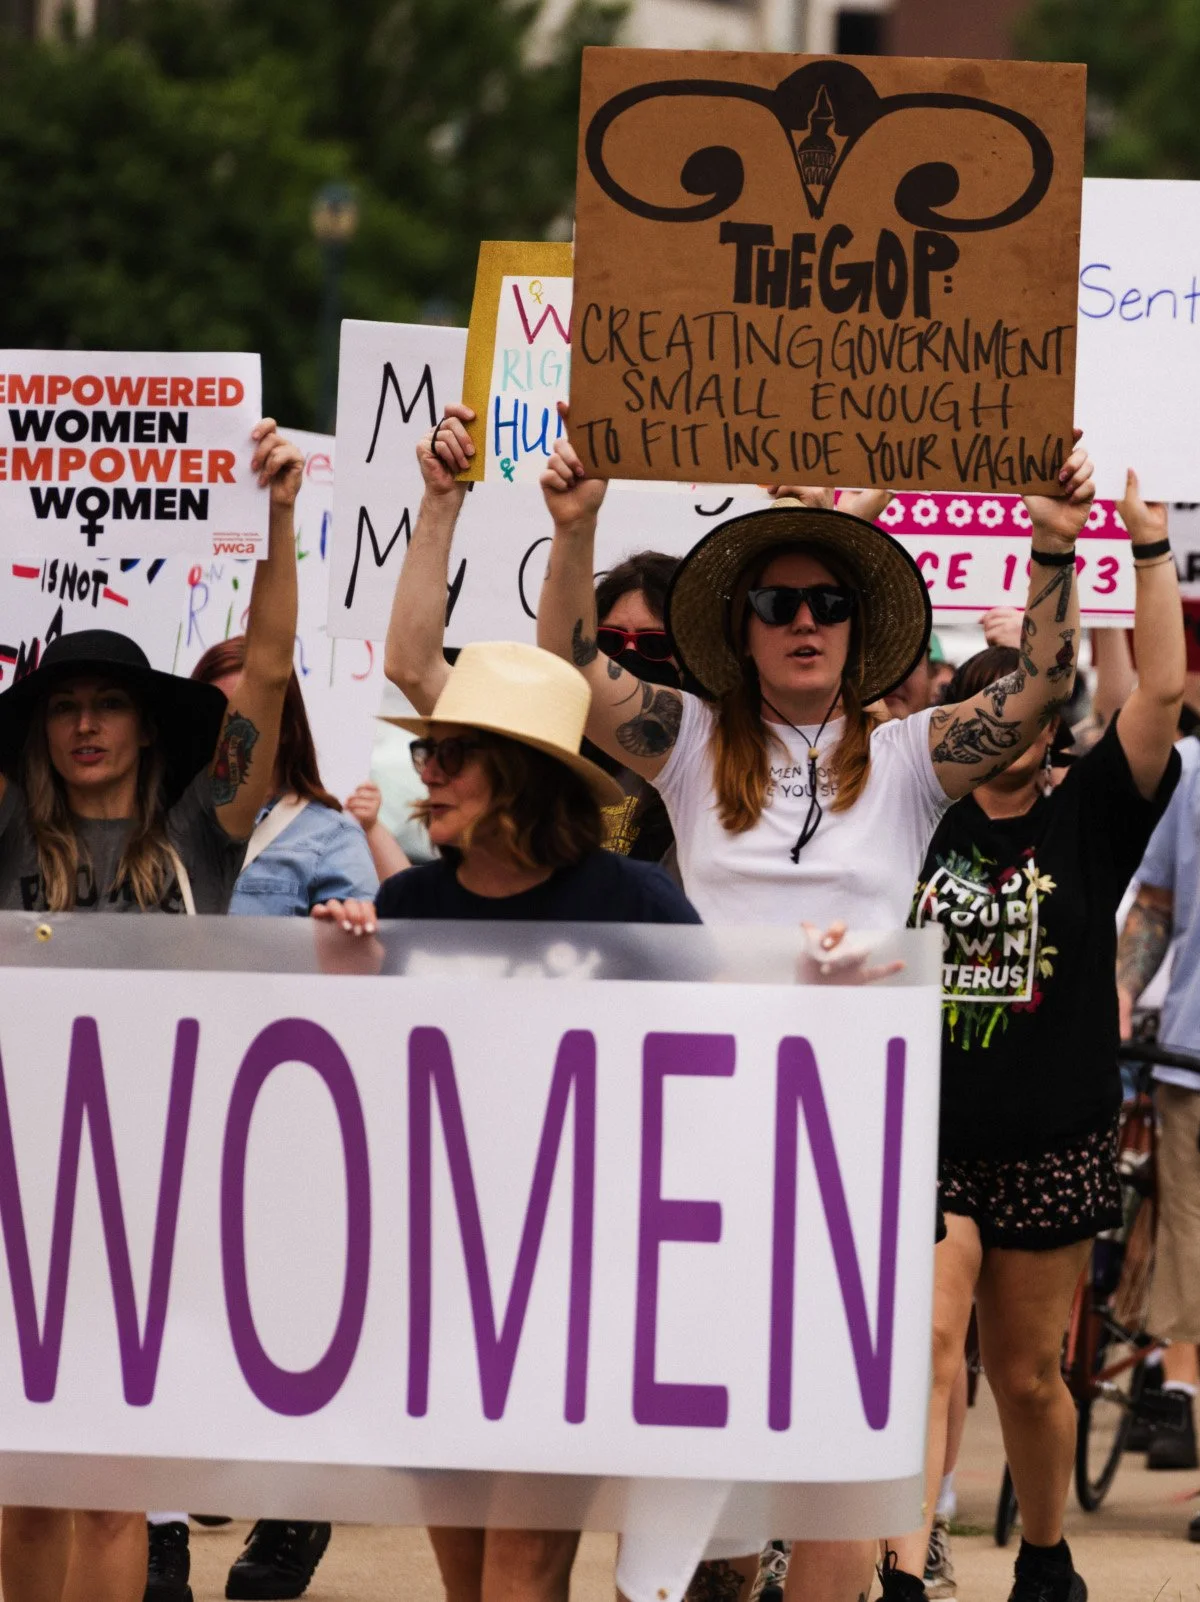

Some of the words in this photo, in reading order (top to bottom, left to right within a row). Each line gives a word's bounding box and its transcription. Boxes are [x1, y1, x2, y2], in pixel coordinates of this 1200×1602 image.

[581, 302, 823, 377] CREATING
[832, 317, 1075, 379] GOVERNMENT
[0, 374, 244, 407] MPOWERED
[622, 368, 781, 419] SMALL
[810, 381, 1014, 430] ENOUGH
[8, 409, 188, 443] WOMEN
[577, 417, 622, 469] TO
[641, 417, 708, 469] FIT
[723, 421, 843, 475] INSIDE
[855, 430, 942, 485] YOUR
[30, 487, 209, 546] WOMEN
[213, 543, 255, 556] ywca
[59, 562, 108, 608] NOT
[943, 931, 1026, 957] WN
[943, 963, 1025, 990] TERUS
[0, 1016, 906, 1433] WOMEN
